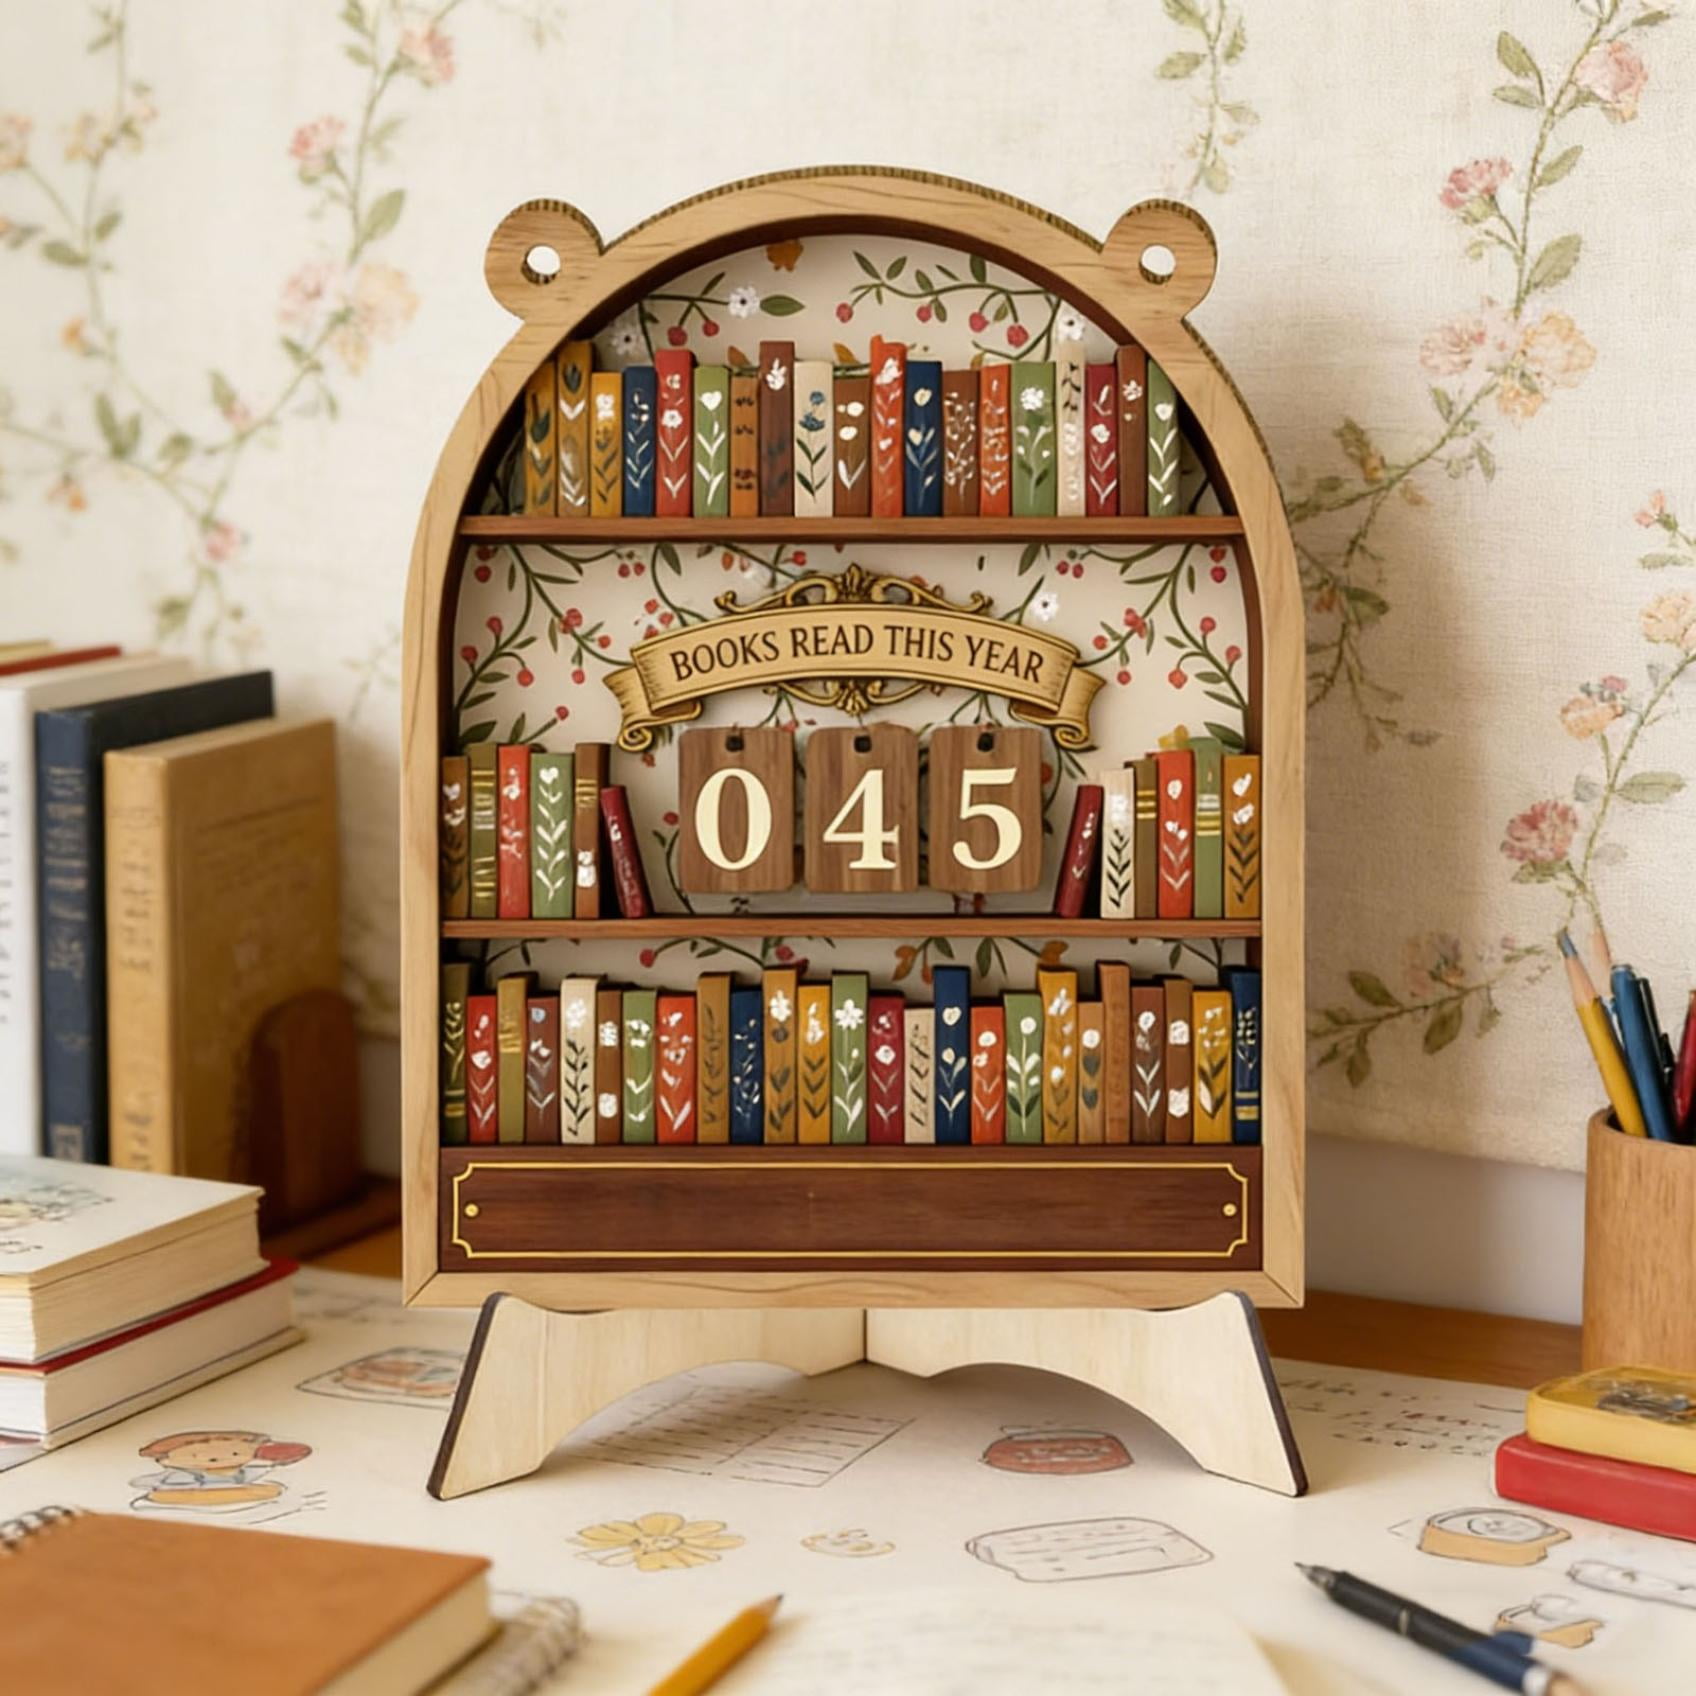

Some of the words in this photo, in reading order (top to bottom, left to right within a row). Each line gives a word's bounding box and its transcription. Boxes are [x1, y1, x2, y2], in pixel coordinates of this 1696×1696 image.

[670, 631, 780, 682] BOOKS
[790, 624, 874, 658] READ
[884, 624, 954, 662] THIS
[965, 634, 1044, 684] YEAR
